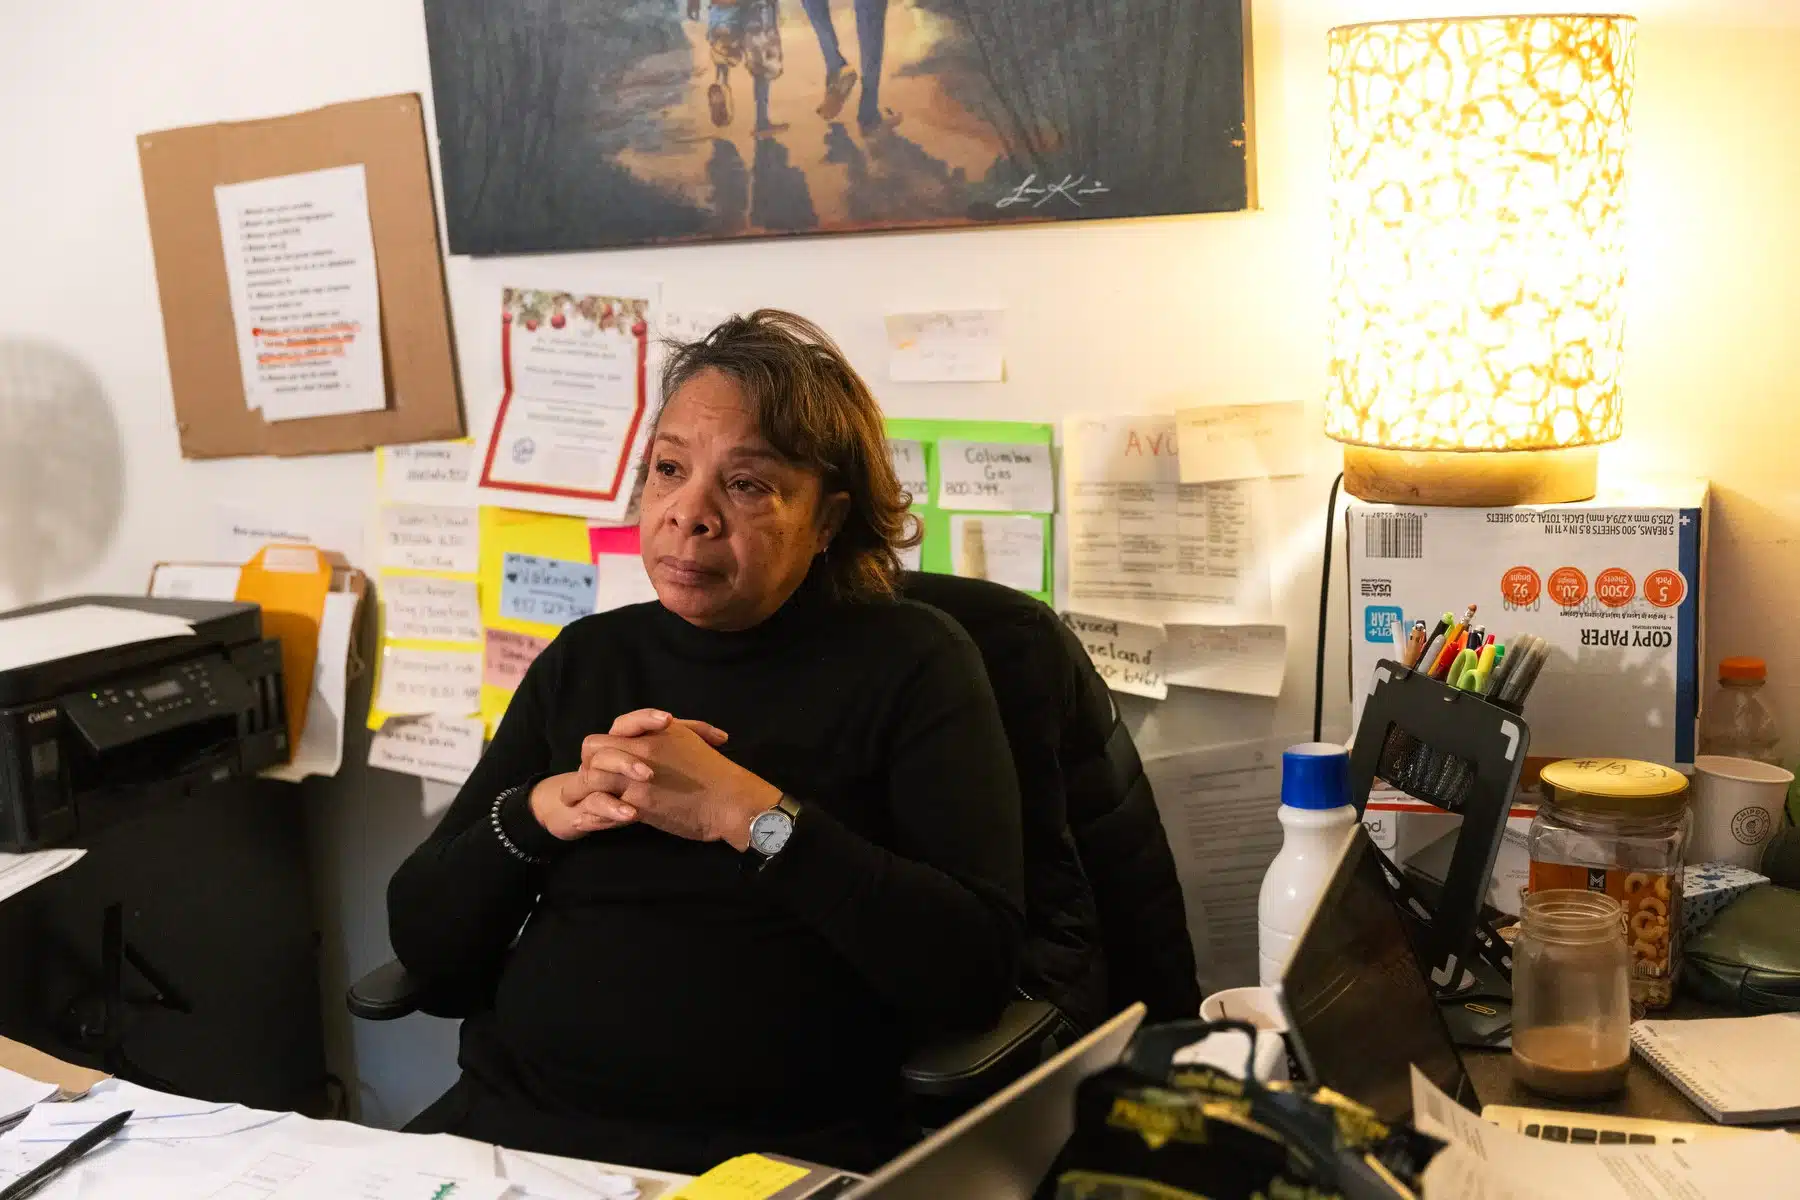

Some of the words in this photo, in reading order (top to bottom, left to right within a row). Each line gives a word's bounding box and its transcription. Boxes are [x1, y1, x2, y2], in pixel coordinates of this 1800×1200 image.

[984, 464, 1012, 481] Gas
[1486, 513, 1514, 522] SHEETS
[1515, 513, 1536, 522] 2,500
[1538, 513, 1560, 523] TOTAL
[1562, 513, 1584, 523] EACH:
[1586, 513, 1605, 524] mm)
[1607, 514, 1626, 523] 279.4
[1651, 513, 1674, 524] (215.9
[1545, 525, 1553, 534] IN
[1554, 525, 1562, 534] 11
[1570, 525, 1577, 534] IN
[1579, 525, 1591, 534] 8.5
[1592, 525, 1621, 535] SHEETS
[1622, 525, 1636, 535] 500
[1637, 525, 1668, 535] REAMS,
[1669, 526, 1674, 535] 5
[1510, 574, 1532, 583] Bright
[1604, 575, 1628, 585] Sheets
[1655, 576, 1673, 586] Pack
[1372, 584, 1392, 592] USA
[1512, 583, 1529, 597] 92
[1601, 585, 1629, 597] 2500
[1659, 586, 1669, 602] 5
[1580, 629, 1629, 647] PAPER
[1632, 630, 1672, 648] COPY
